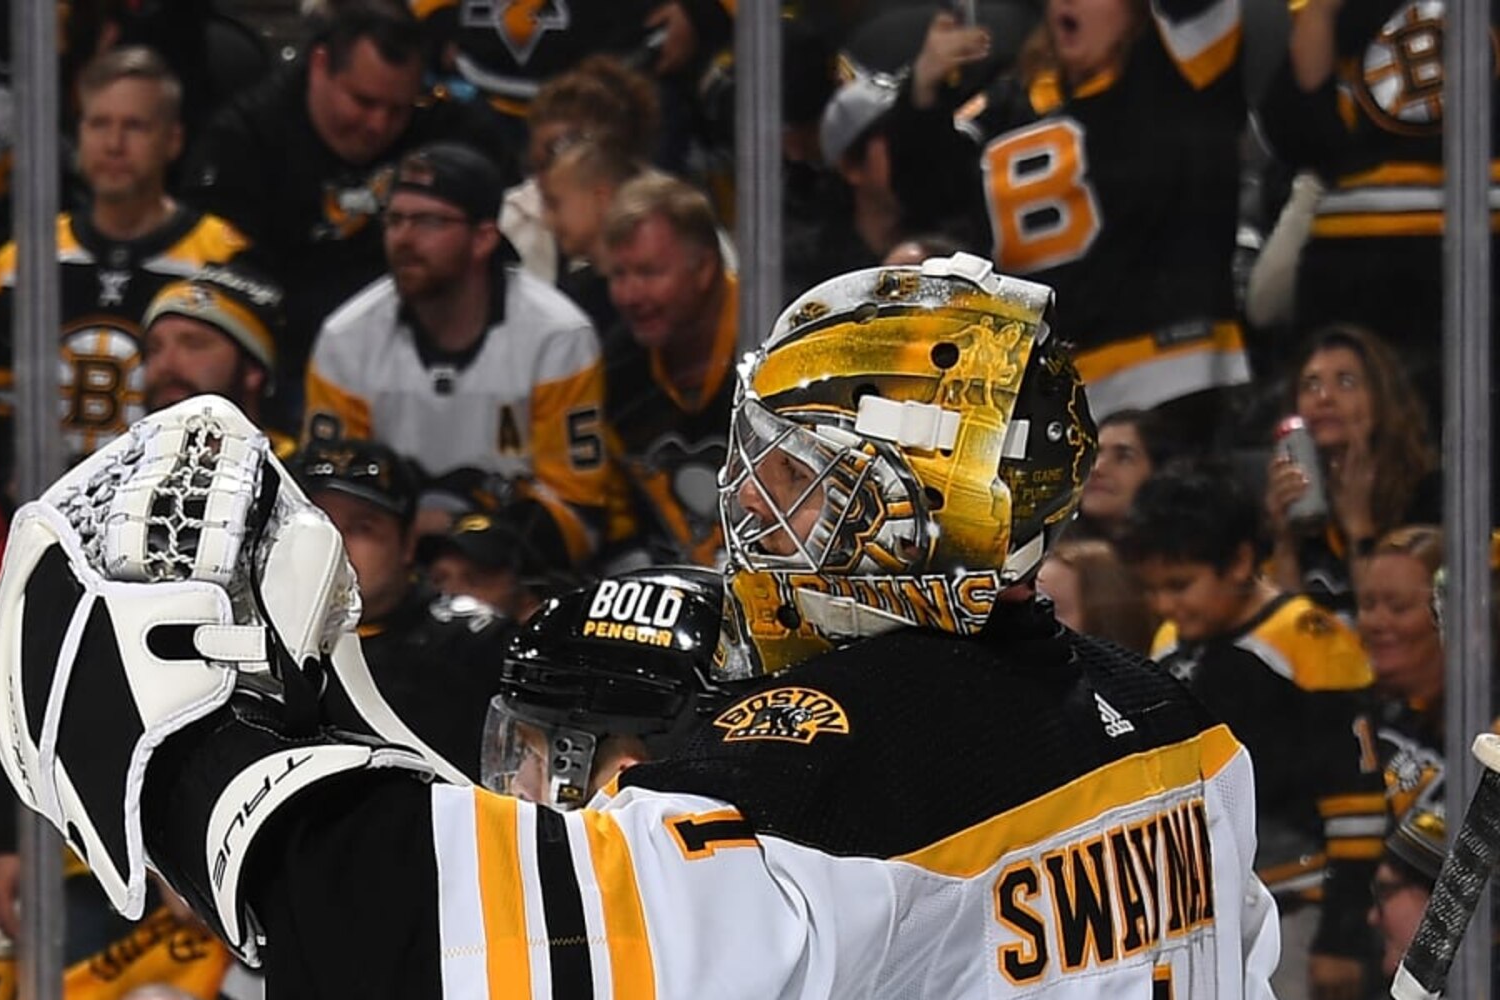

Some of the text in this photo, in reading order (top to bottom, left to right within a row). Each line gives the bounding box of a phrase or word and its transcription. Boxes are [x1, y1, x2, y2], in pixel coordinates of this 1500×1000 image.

[983, 118, 1100, 272] B
[566, 407, 603, 473] 5
[588, 580, 684, 628] BOLD
[583, 620, 674, 648] PENGUIN
[718, 688, 844, 732] BOSTON
[212, 754, 314, 893] TRUE
